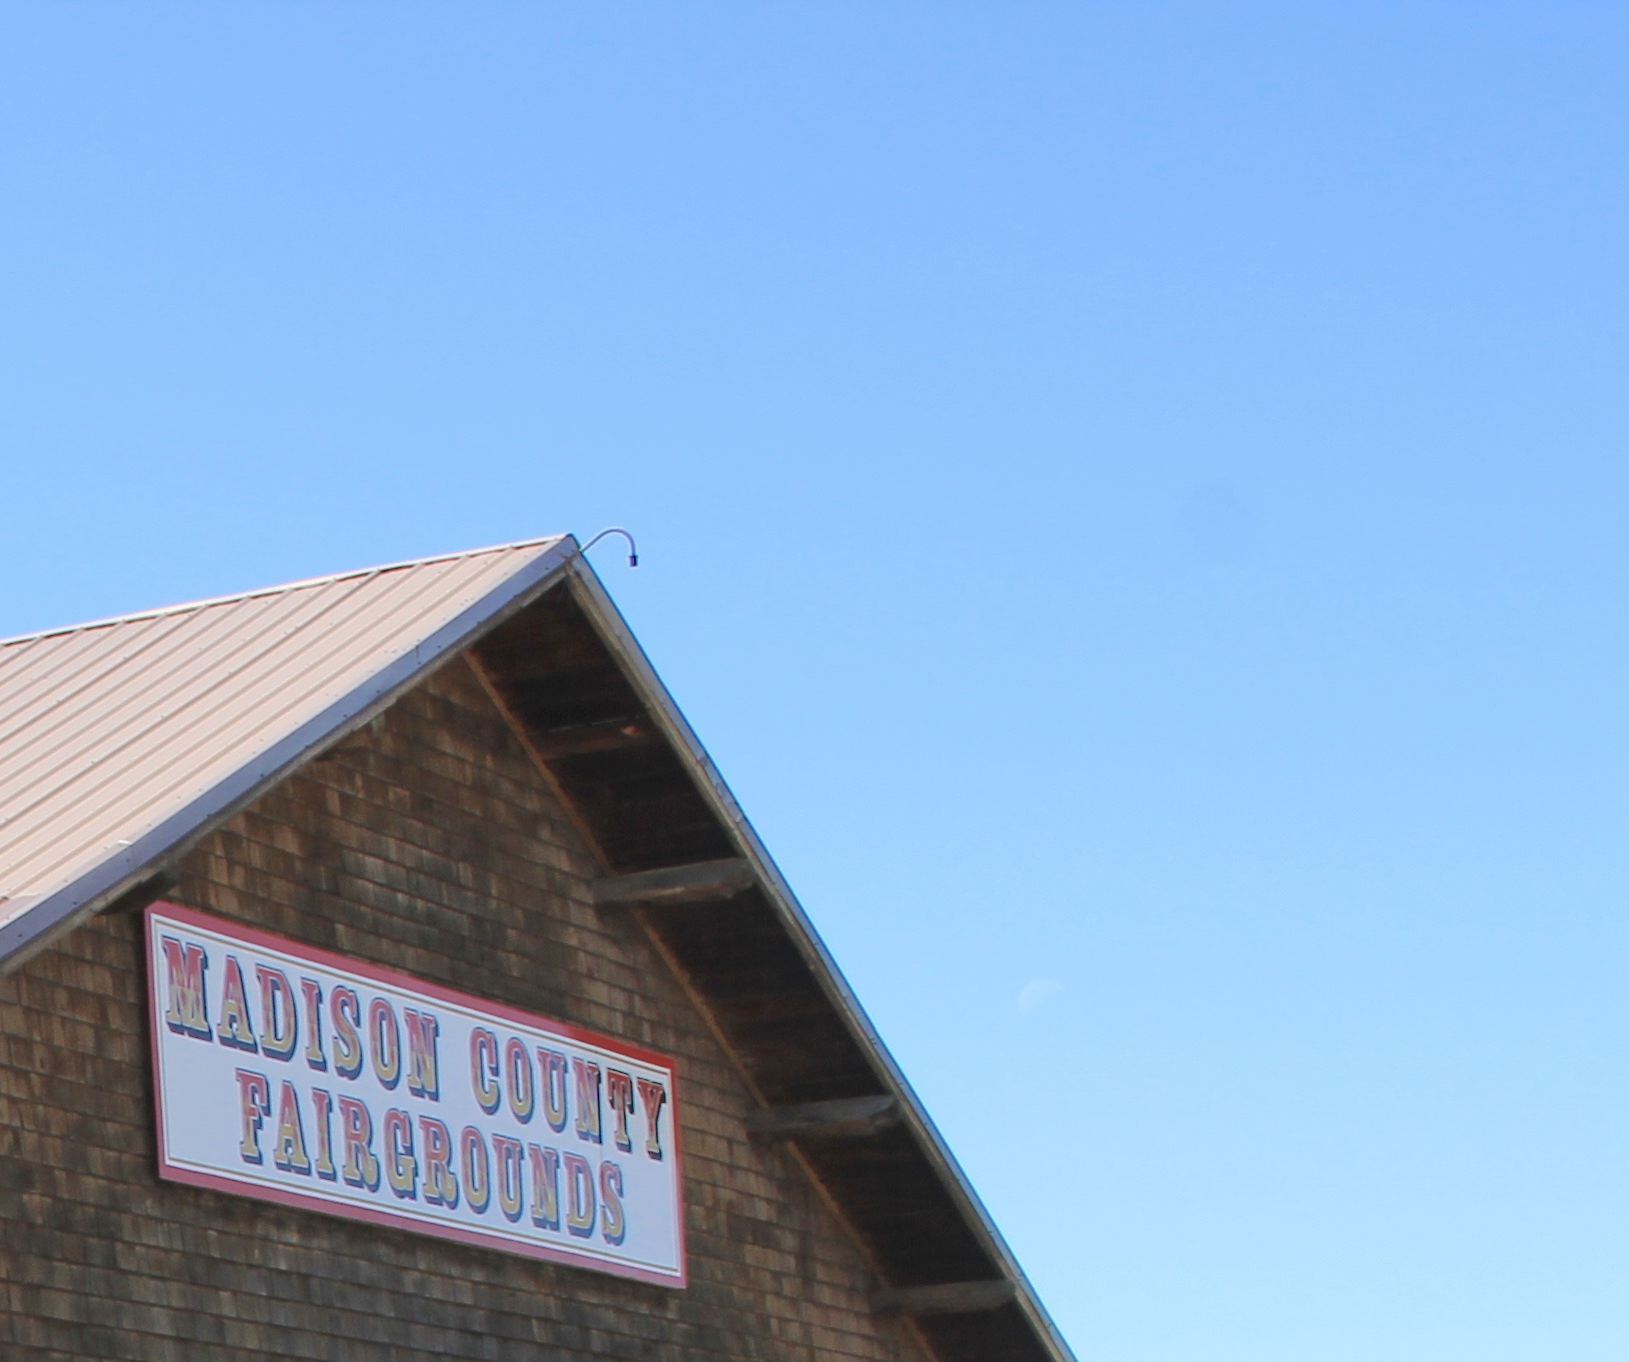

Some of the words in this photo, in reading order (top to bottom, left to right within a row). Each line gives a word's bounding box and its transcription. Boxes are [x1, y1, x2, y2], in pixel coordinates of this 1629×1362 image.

[161, 934, 441, 1102] MADISON
[469, 1026, 668, 1161] COUNTY
[235, 1066, 626, 1247] FAIRGROUNDS
